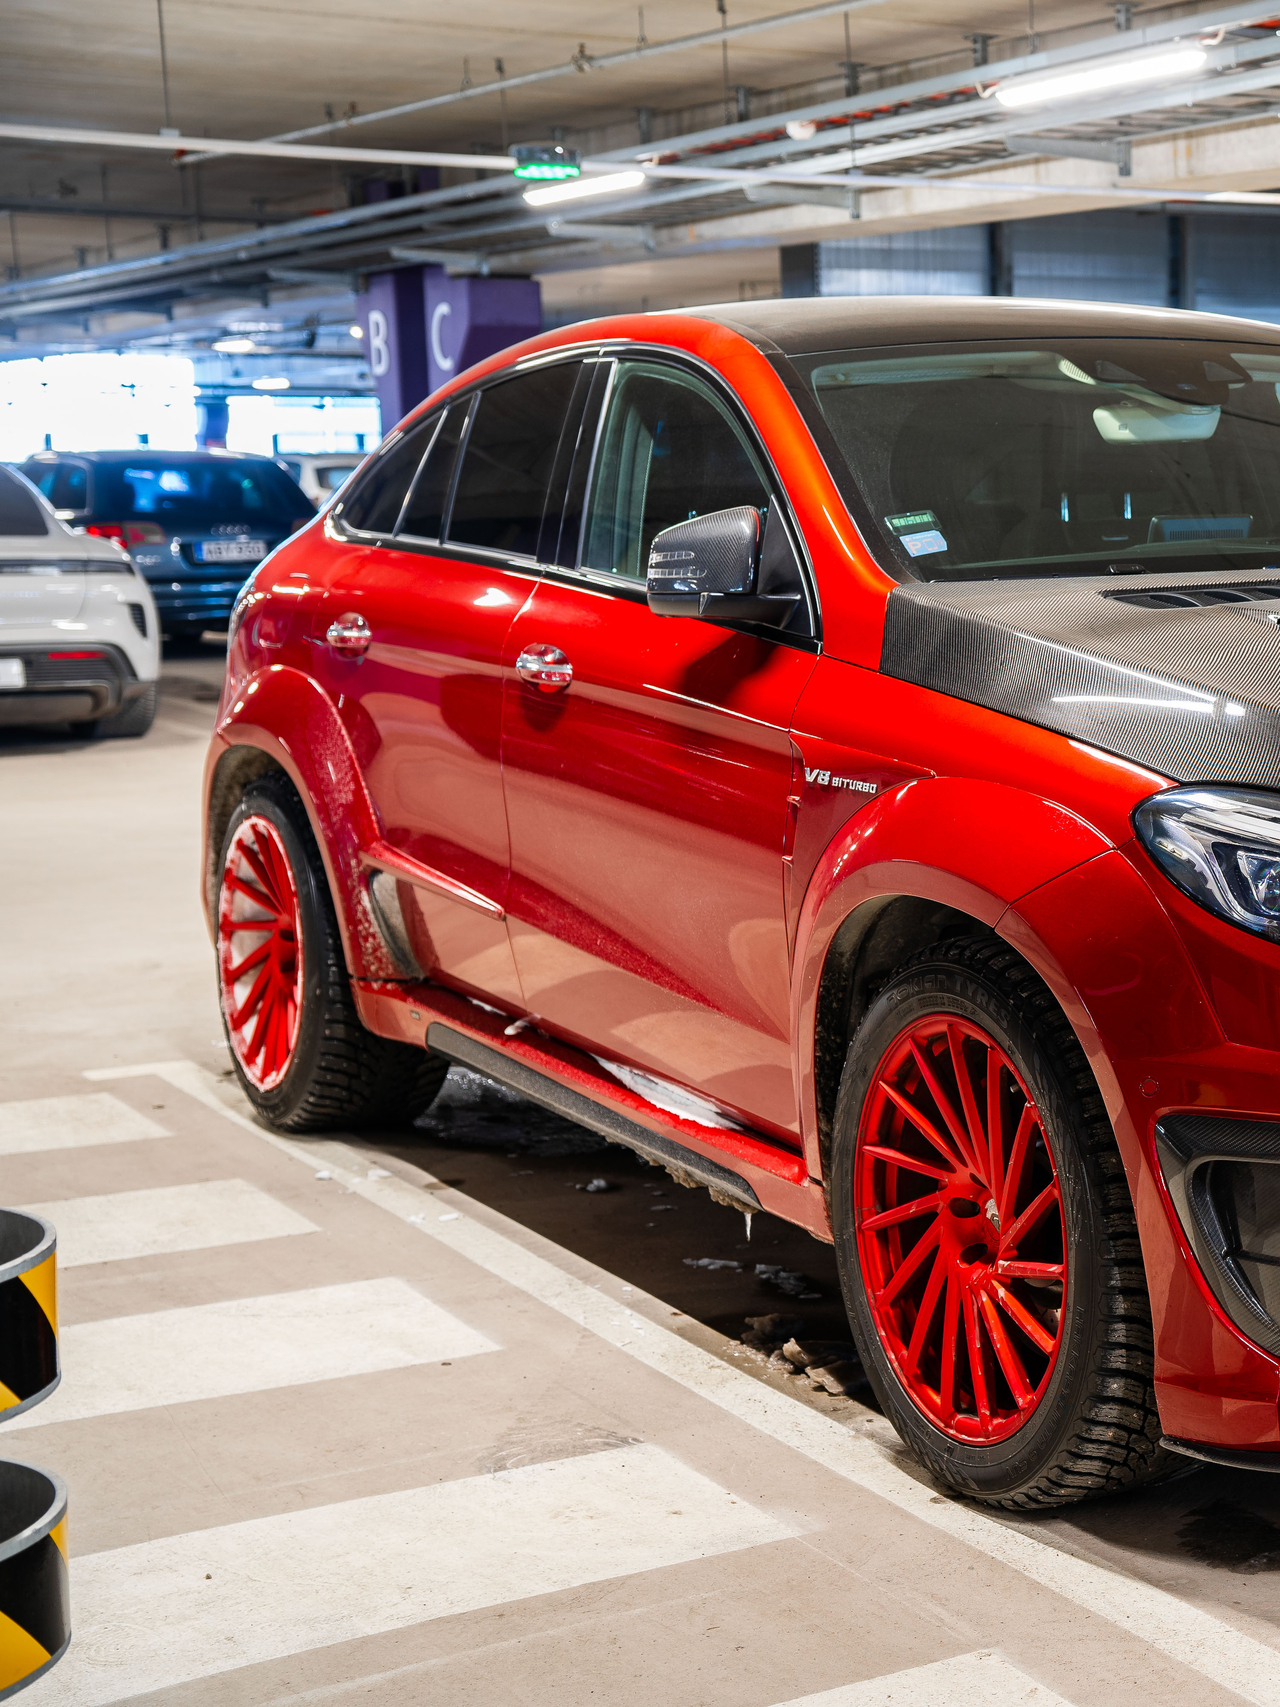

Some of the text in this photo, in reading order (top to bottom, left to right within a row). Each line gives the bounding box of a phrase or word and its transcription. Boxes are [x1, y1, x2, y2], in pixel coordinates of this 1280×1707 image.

[368, 309, 389, 376] B
[431, 301, 454, 371] C
[804, 767, 877, 793] V8 BITURBO
[954, 974, 1010, 1029] TYRES
